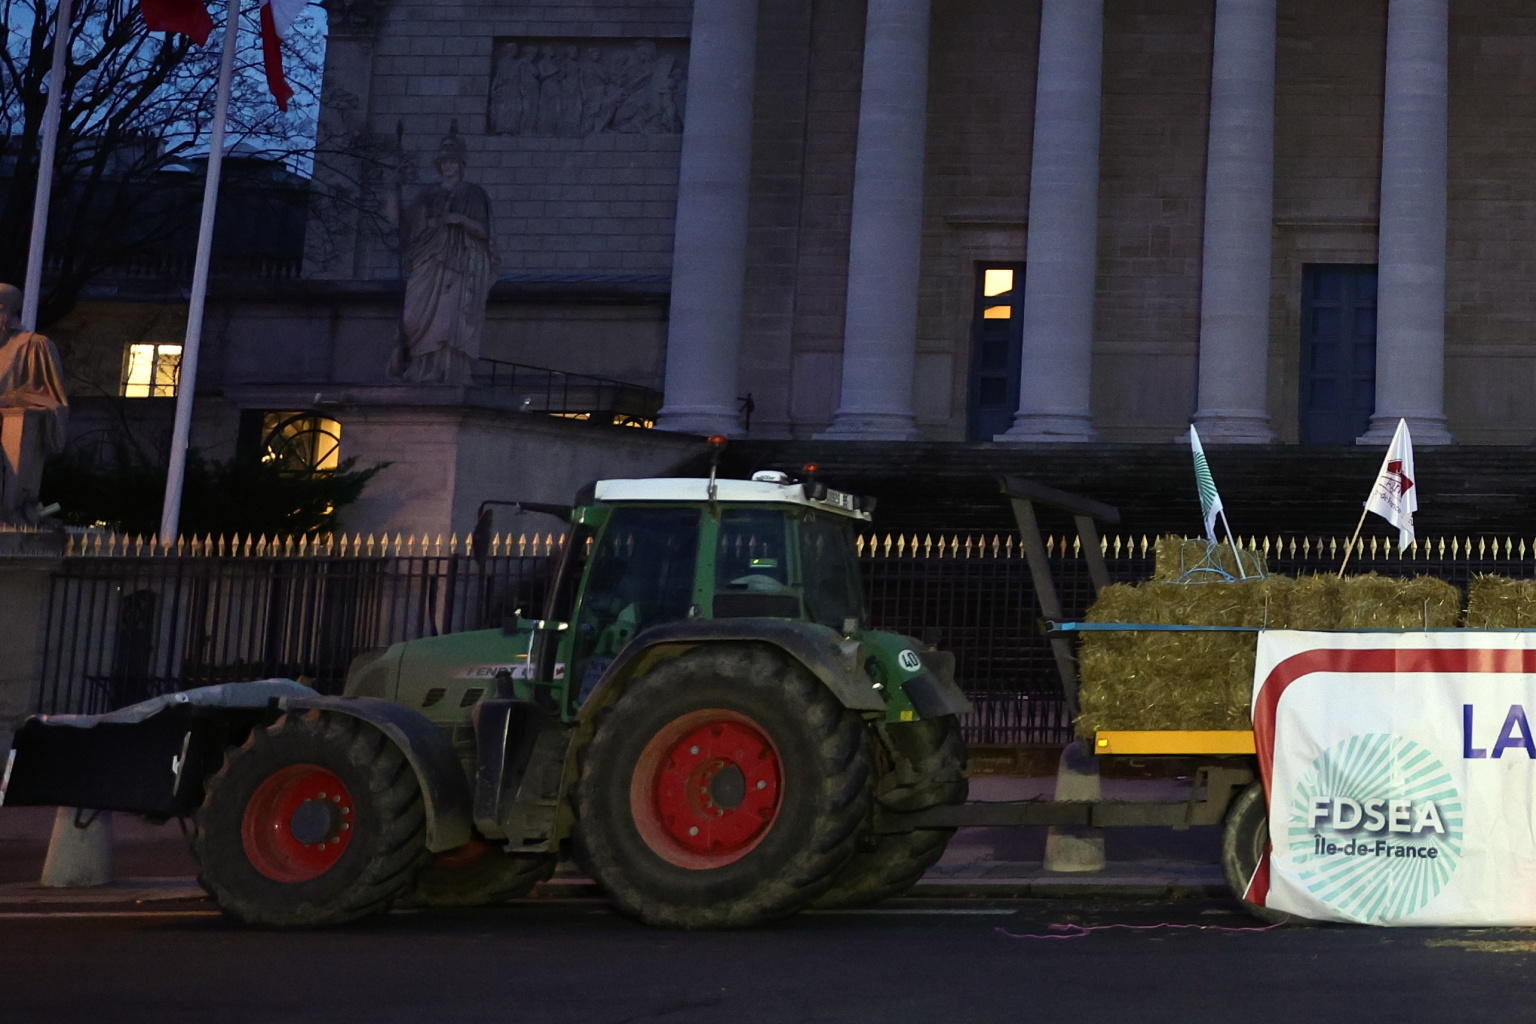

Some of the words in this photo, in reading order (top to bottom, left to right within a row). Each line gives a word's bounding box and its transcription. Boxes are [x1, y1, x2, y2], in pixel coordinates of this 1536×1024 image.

[902, 652, 919, 668] 40
[1308, 795, 1446, 834] FDSEA
[1314, 834, 1439, 859] Île-de-France
